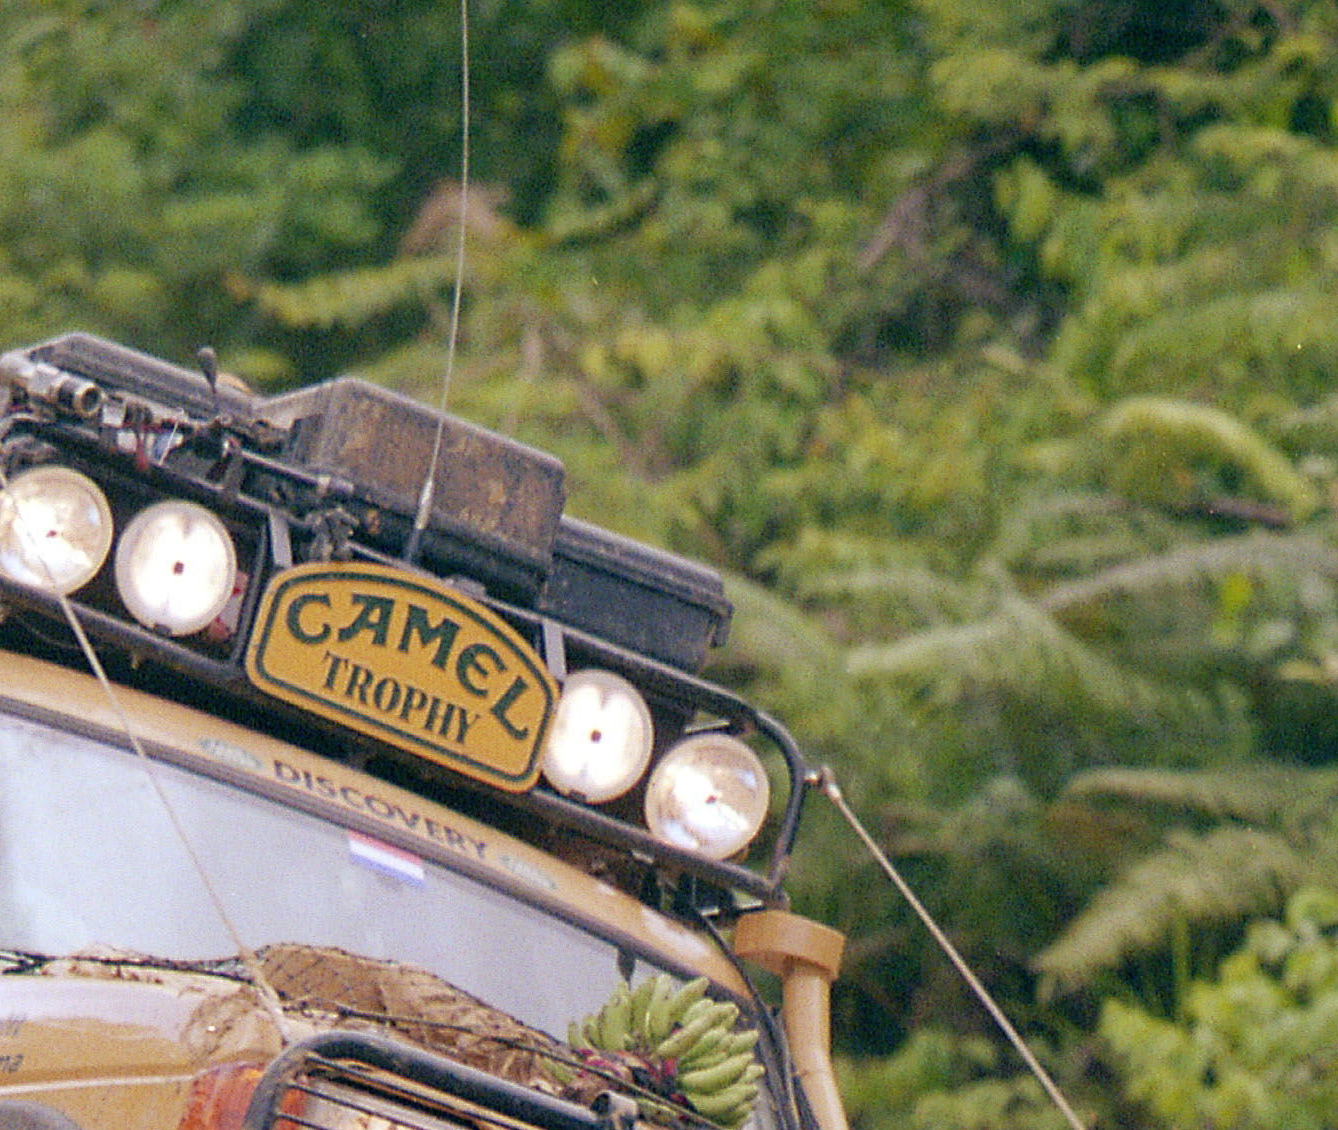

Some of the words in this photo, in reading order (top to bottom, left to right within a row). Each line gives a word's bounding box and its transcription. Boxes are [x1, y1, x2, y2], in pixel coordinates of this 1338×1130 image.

[286, 593, 530, 740] CAMEL
[324, 651, 480, 744] TROPHY
[275, 761, 487, 859] DISCOVERY
